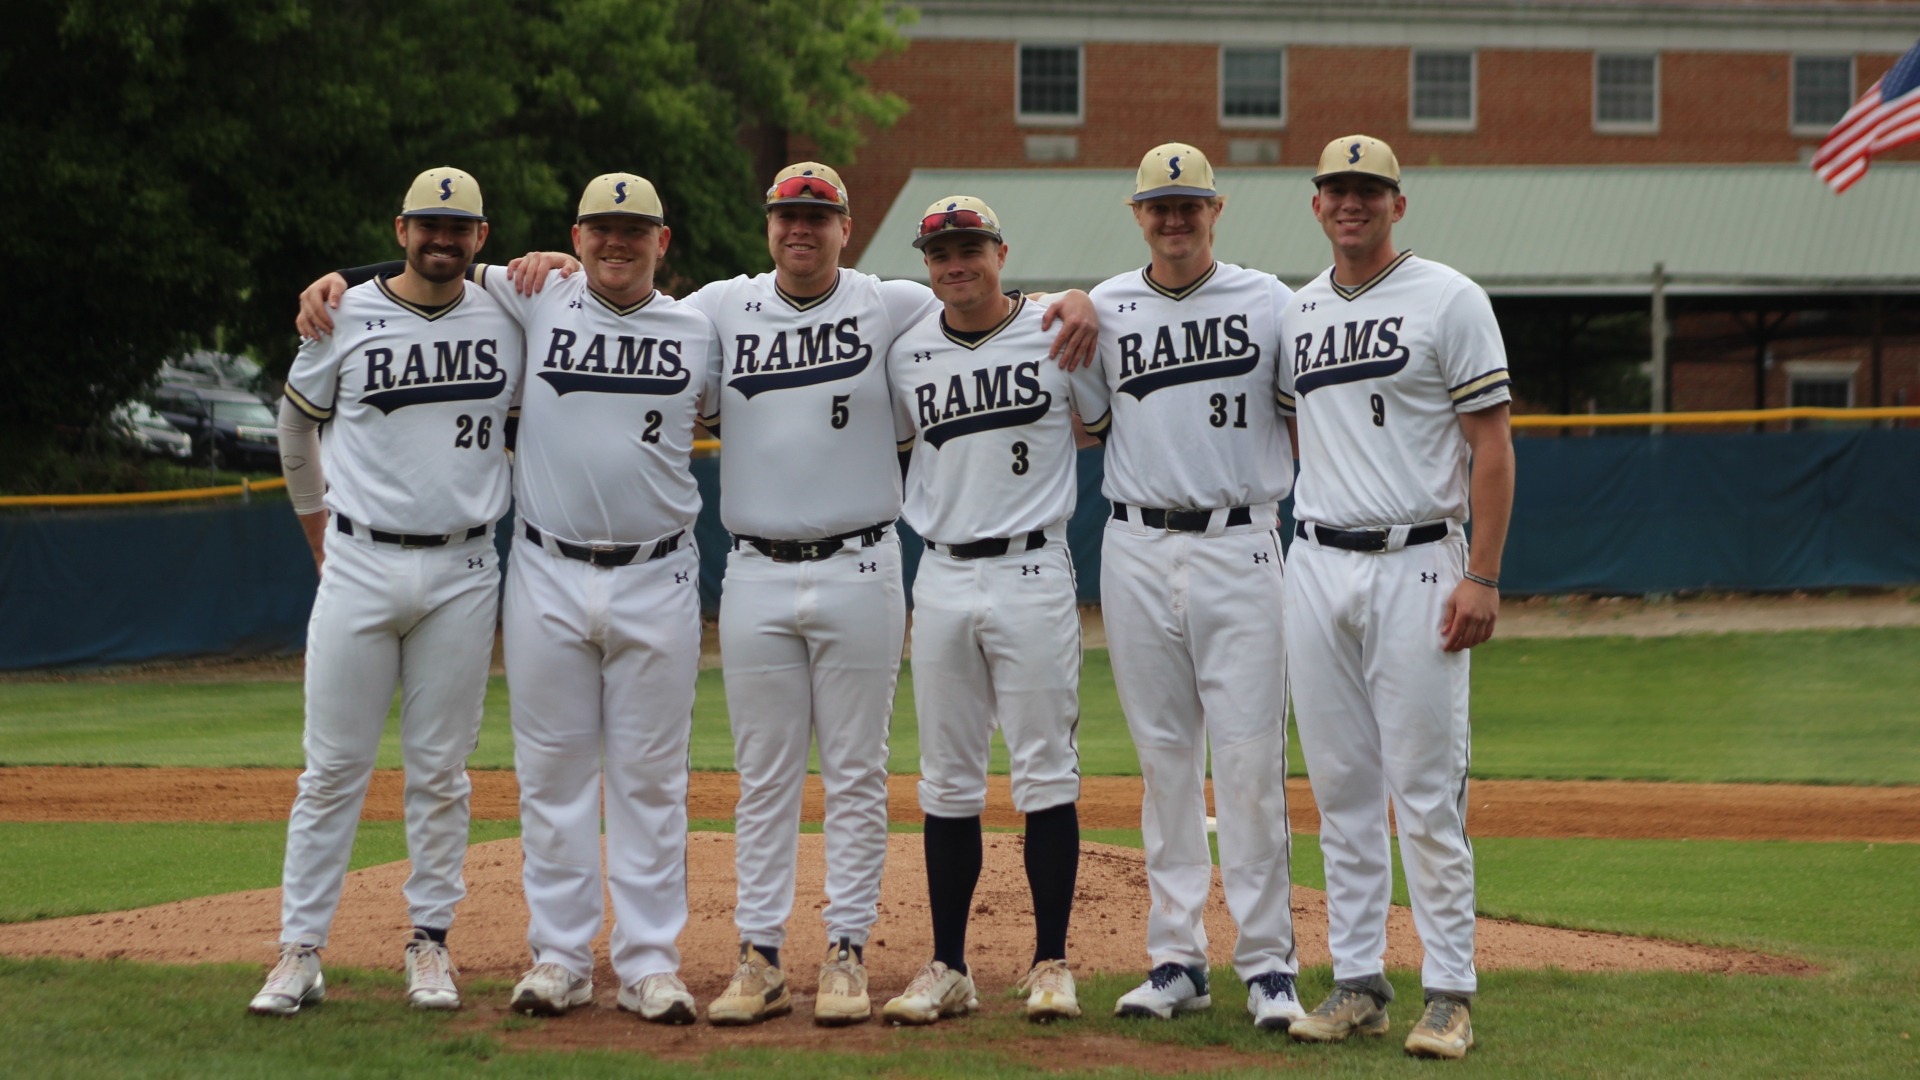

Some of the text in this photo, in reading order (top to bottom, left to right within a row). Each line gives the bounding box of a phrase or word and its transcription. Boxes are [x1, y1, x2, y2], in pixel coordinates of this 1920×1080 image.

[1168, 156, 1181, 180] S
[1348, 143, 1361, 165] S
[439, 178, 453, 200] S
[613, 182, 628, 204] S
[543, 327, 683, 378] RAMS
[733, 316, 862, 374] RAMS
[1117, 313, 1251, 379] RAMS
[1294, 316, 1404, 375] RAMS
[363, 338, 498, 392] RAMS
[914, 361, 1040, 429] RAMS
[1209, 392, 1248, 429] 31
[1370, 393, 1386, 428] 9
[641, 410, 662, 444] 2
[831, 396, 849, 430] 5
[455, 414, 492, 450] 26
[1011, 441, 1029, 476] 3
